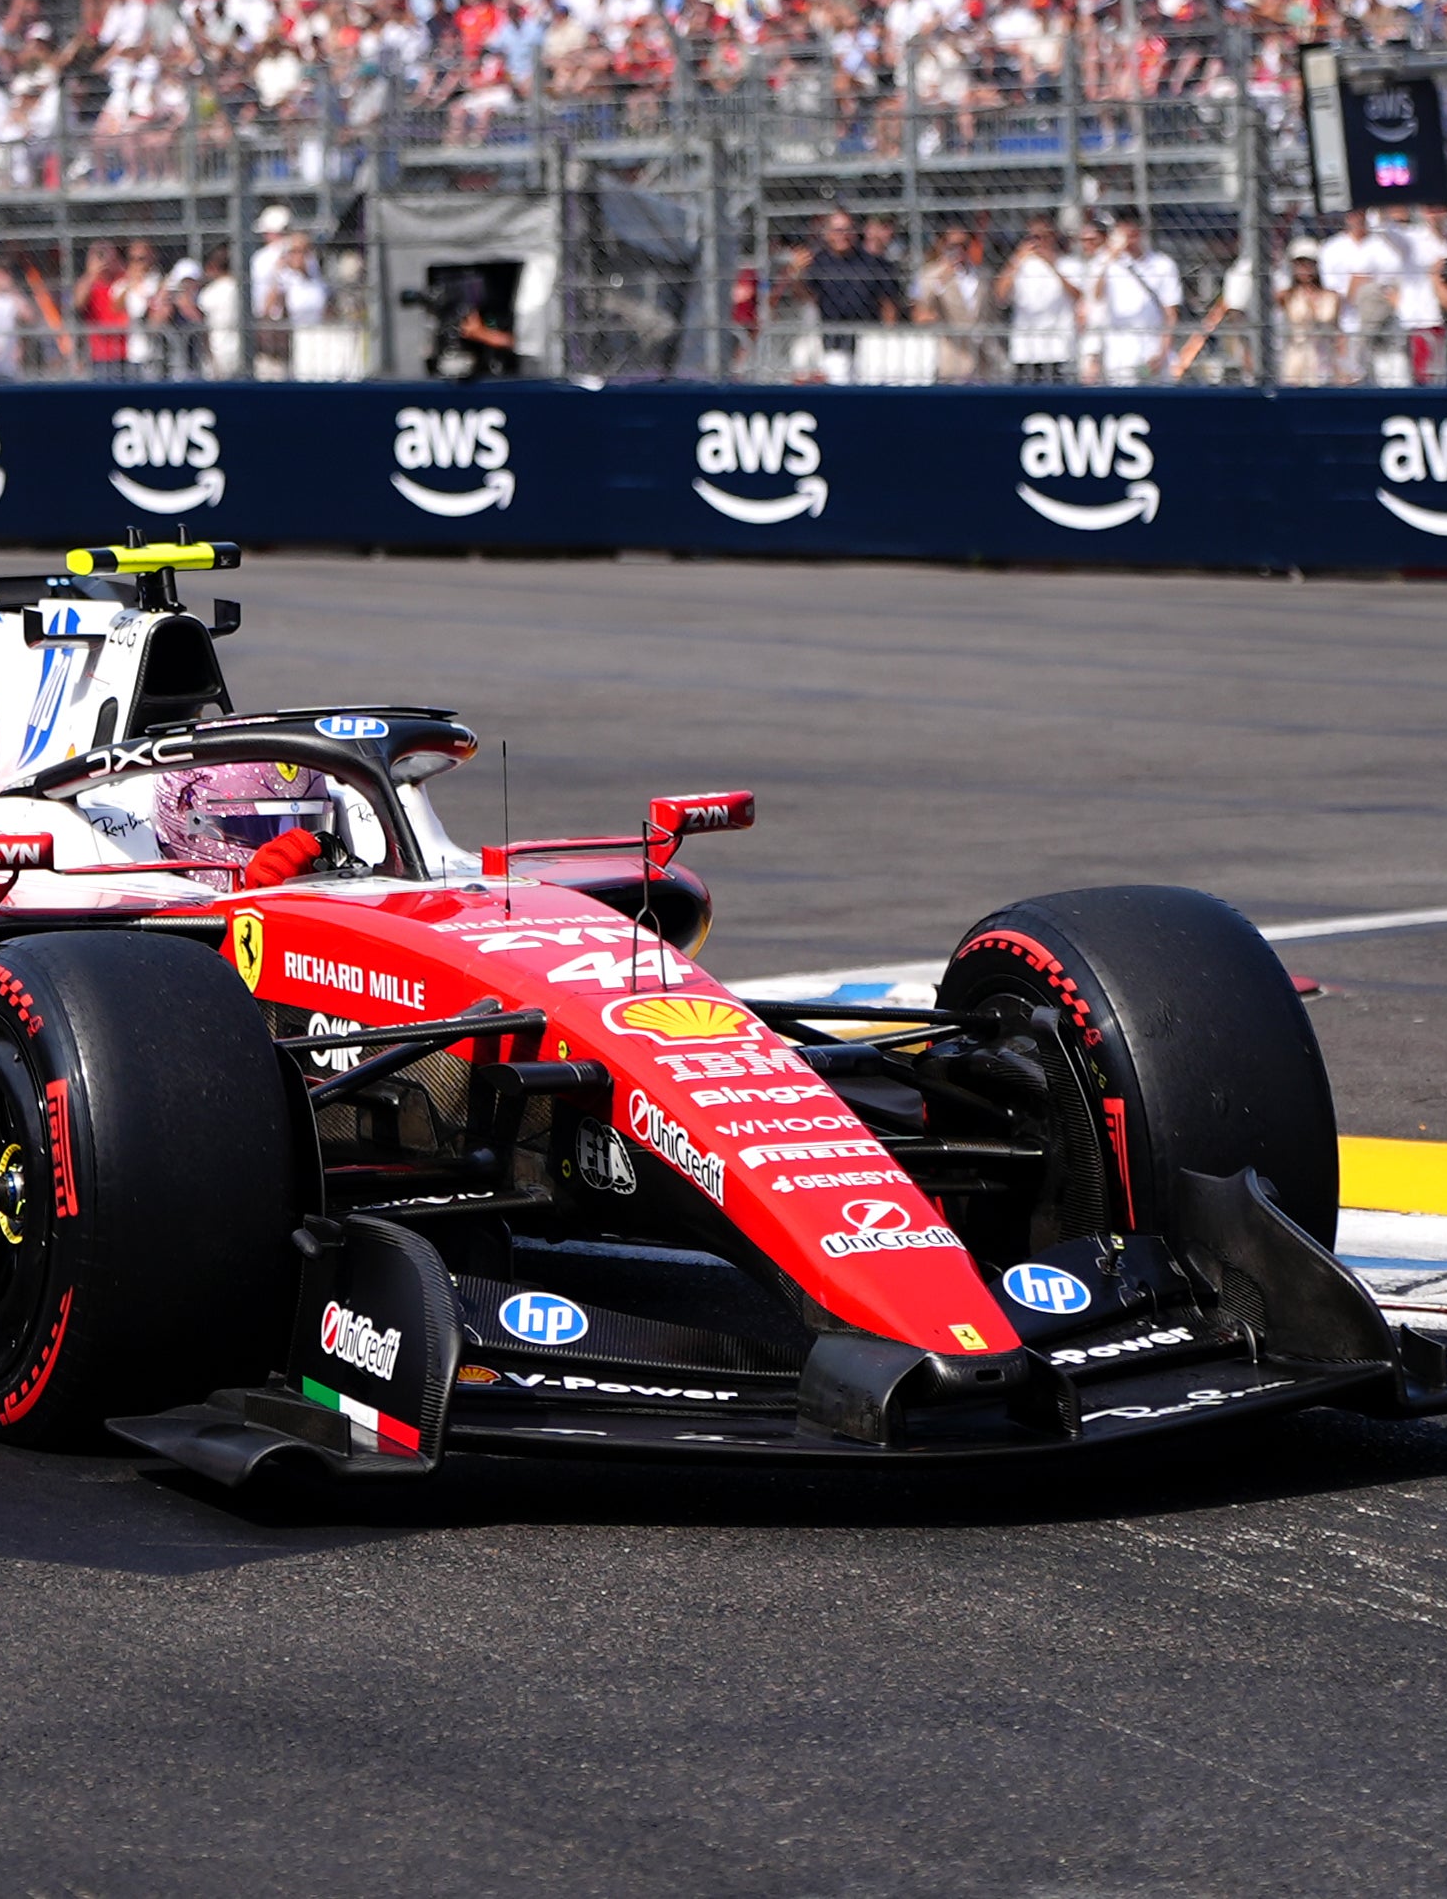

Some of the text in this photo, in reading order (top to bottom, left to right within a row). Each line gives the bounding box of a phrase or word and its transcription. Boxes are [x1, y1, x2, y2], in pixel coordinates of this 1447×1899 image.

[111, 407, 221, 468] aws
[394, 407, 510, 471] aws
[695, 410, 822, 476] aws
[1019, 413, 1155, 480] aws
[684, 804, 730, 828] ZYN
[460, 926, 662, 954] ZYN
[284, 951, 426, 1011] RICHARD MILLE
[546, 948, 694, 989] 44
[654, 1048, 815, 1083] IBM
[716, 1114, 862, 1138] WHOOP
[45, 1078, 80, 1219] PIRELLI
[649, 1103, 726, 1207] UniCredit
[738, 1138, 891, 1170] PIRELLI
[793, 1169, 914, 1190] GENESYS
[821, 1226, 968, 1258] UniCredit
[334, 1307, 401, 1381] UniCredit
[1050, 1326, 1194, 1366] -Power
[504, 1371, 739, 1401] V-Power
